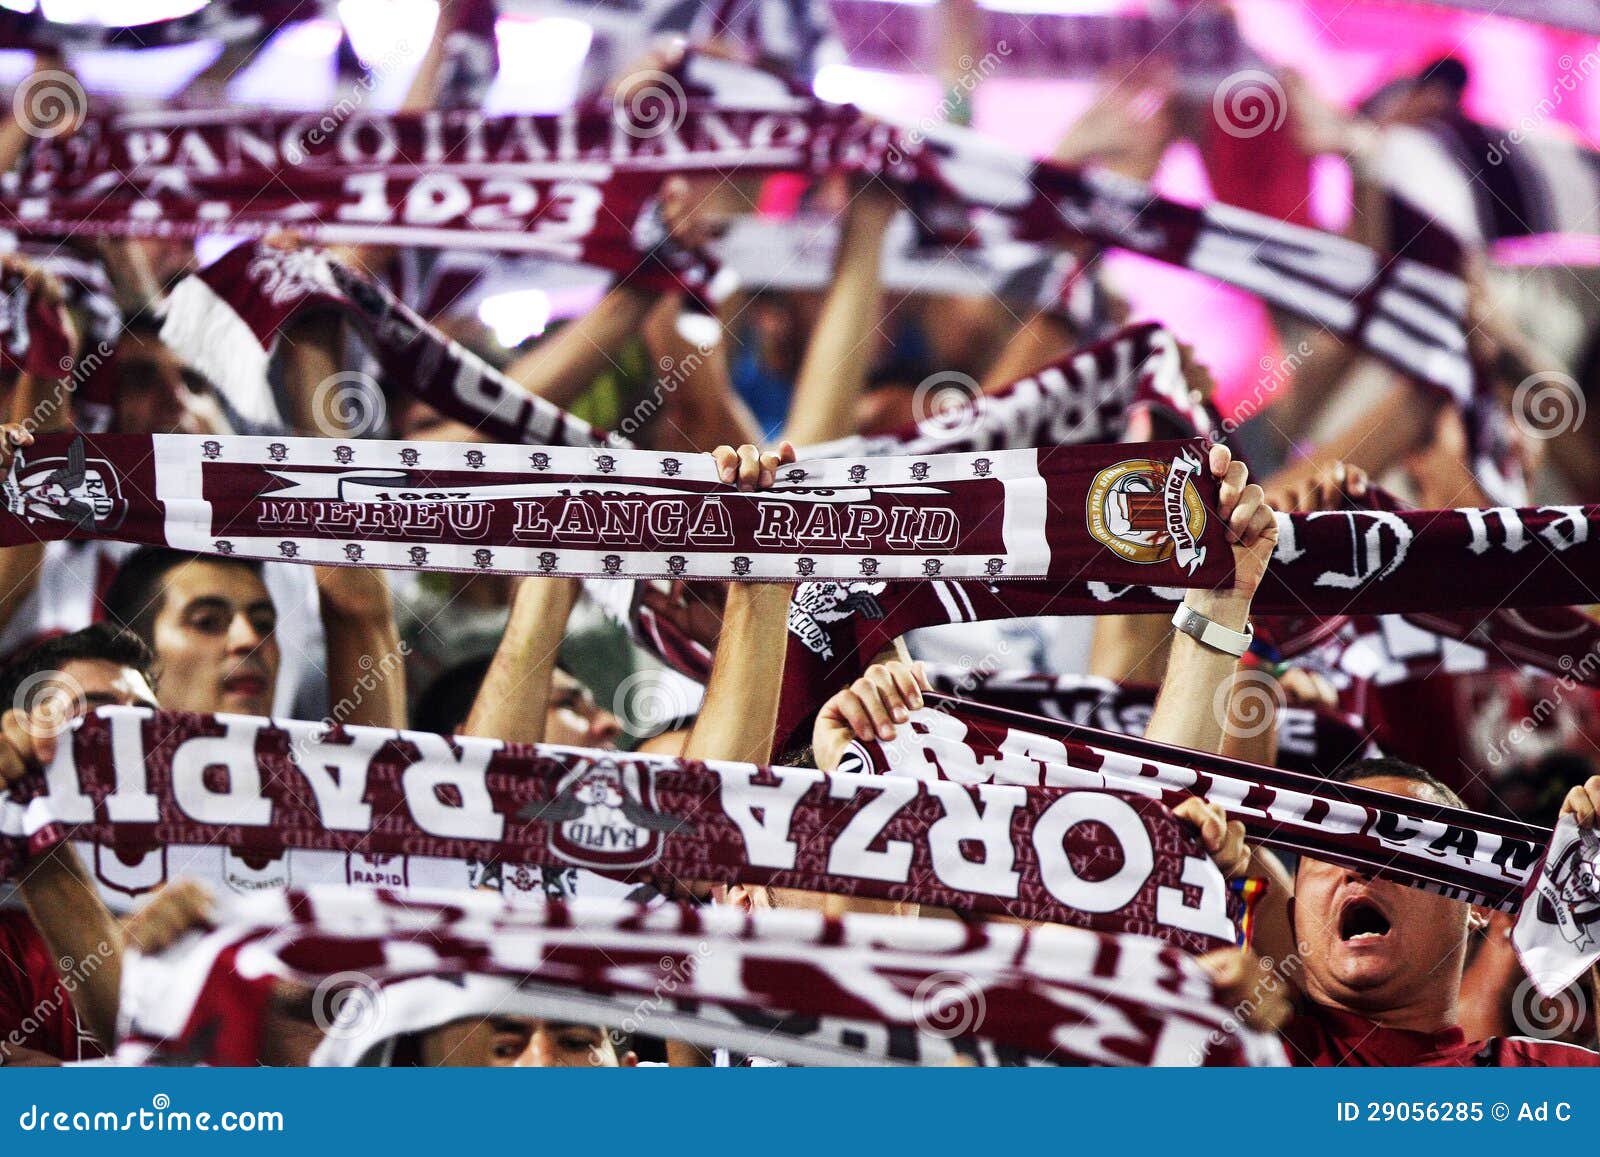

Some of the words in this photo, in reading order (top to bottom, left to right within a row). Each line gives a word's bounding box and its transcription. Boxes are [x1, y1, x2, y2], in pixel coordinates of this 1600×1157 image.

[257, 500, 495, 540] MEREU
[754, 501, 960, 550] RAPID
[1167, 468, 1192, 550] ALCOOLICA
[568, 820, 638, 851] RAPID
[719, 761, 1236, 944] FORZA
[353, 870, 402, 886] RAPID
